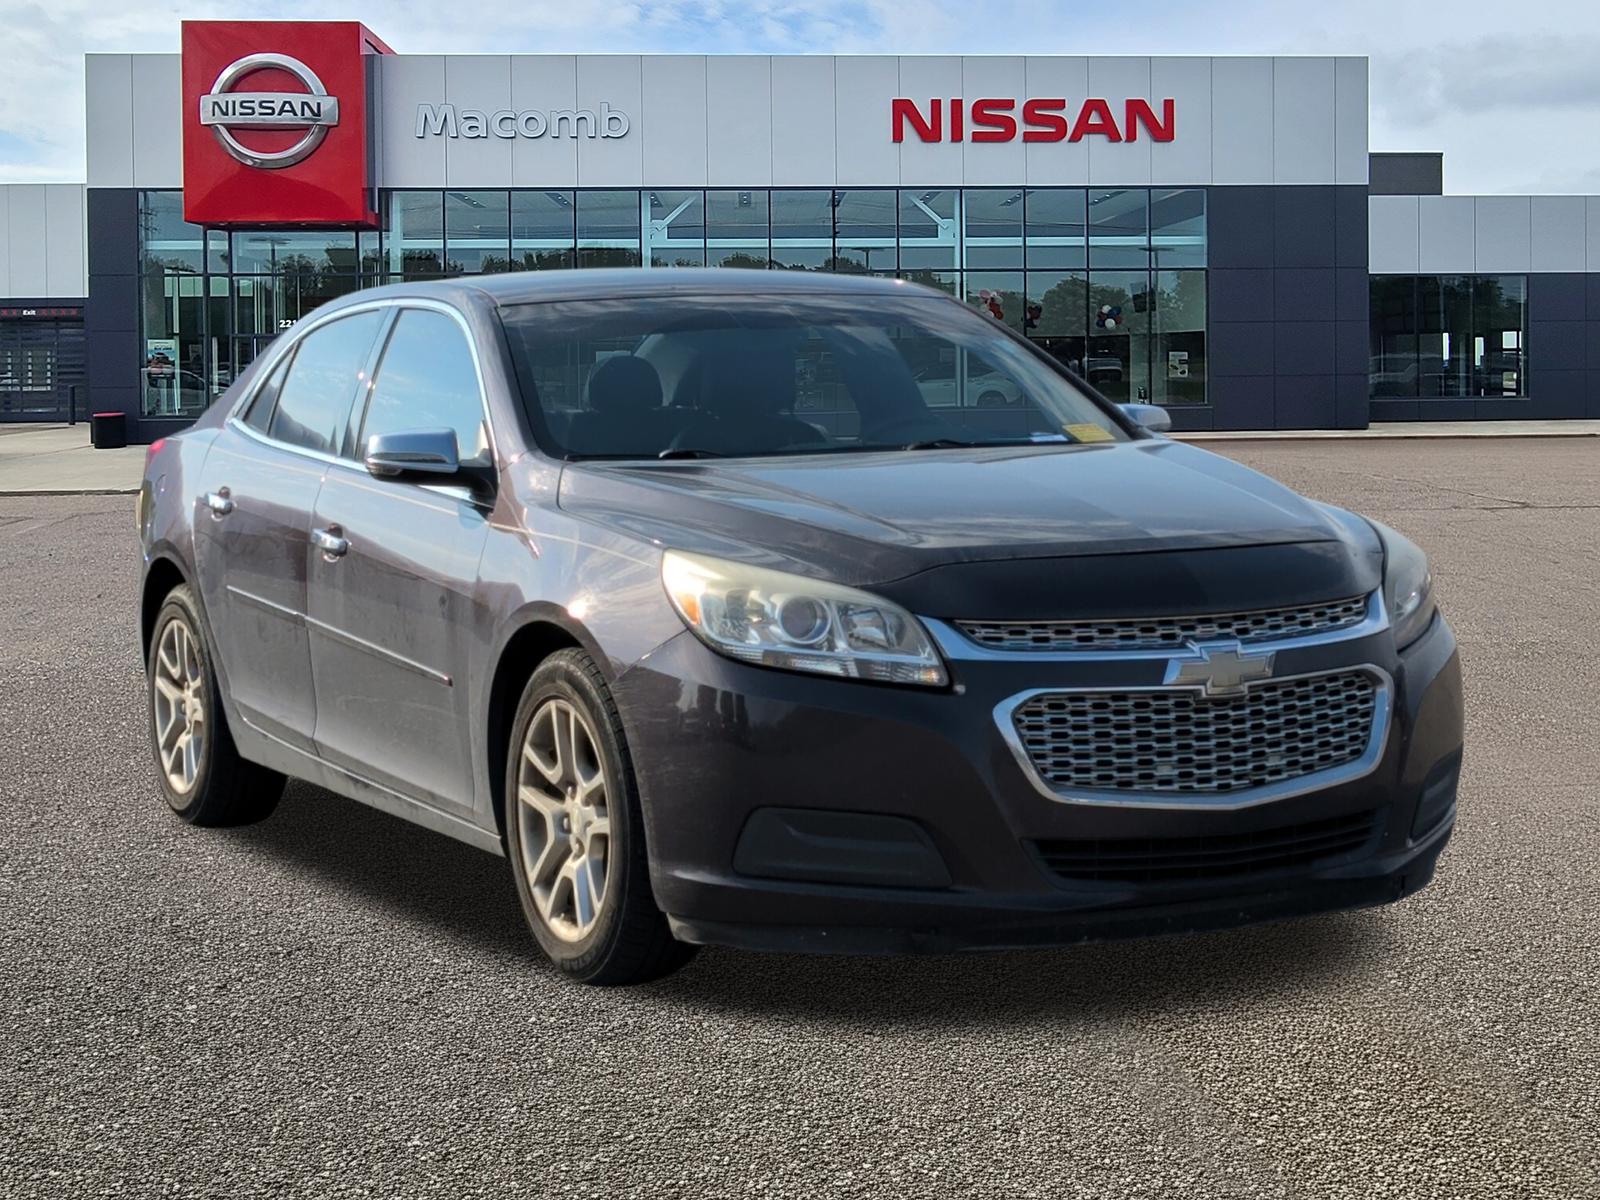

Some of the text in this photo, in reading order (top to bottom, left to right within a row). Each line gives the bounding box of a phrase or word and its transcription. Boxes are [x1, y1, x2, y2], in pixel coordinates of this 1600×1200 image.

[211, 100, 322, 118] NISSAN
[415, 102, 630, 139] Macomb
[892, 98, 1175, 143] NISSAN
